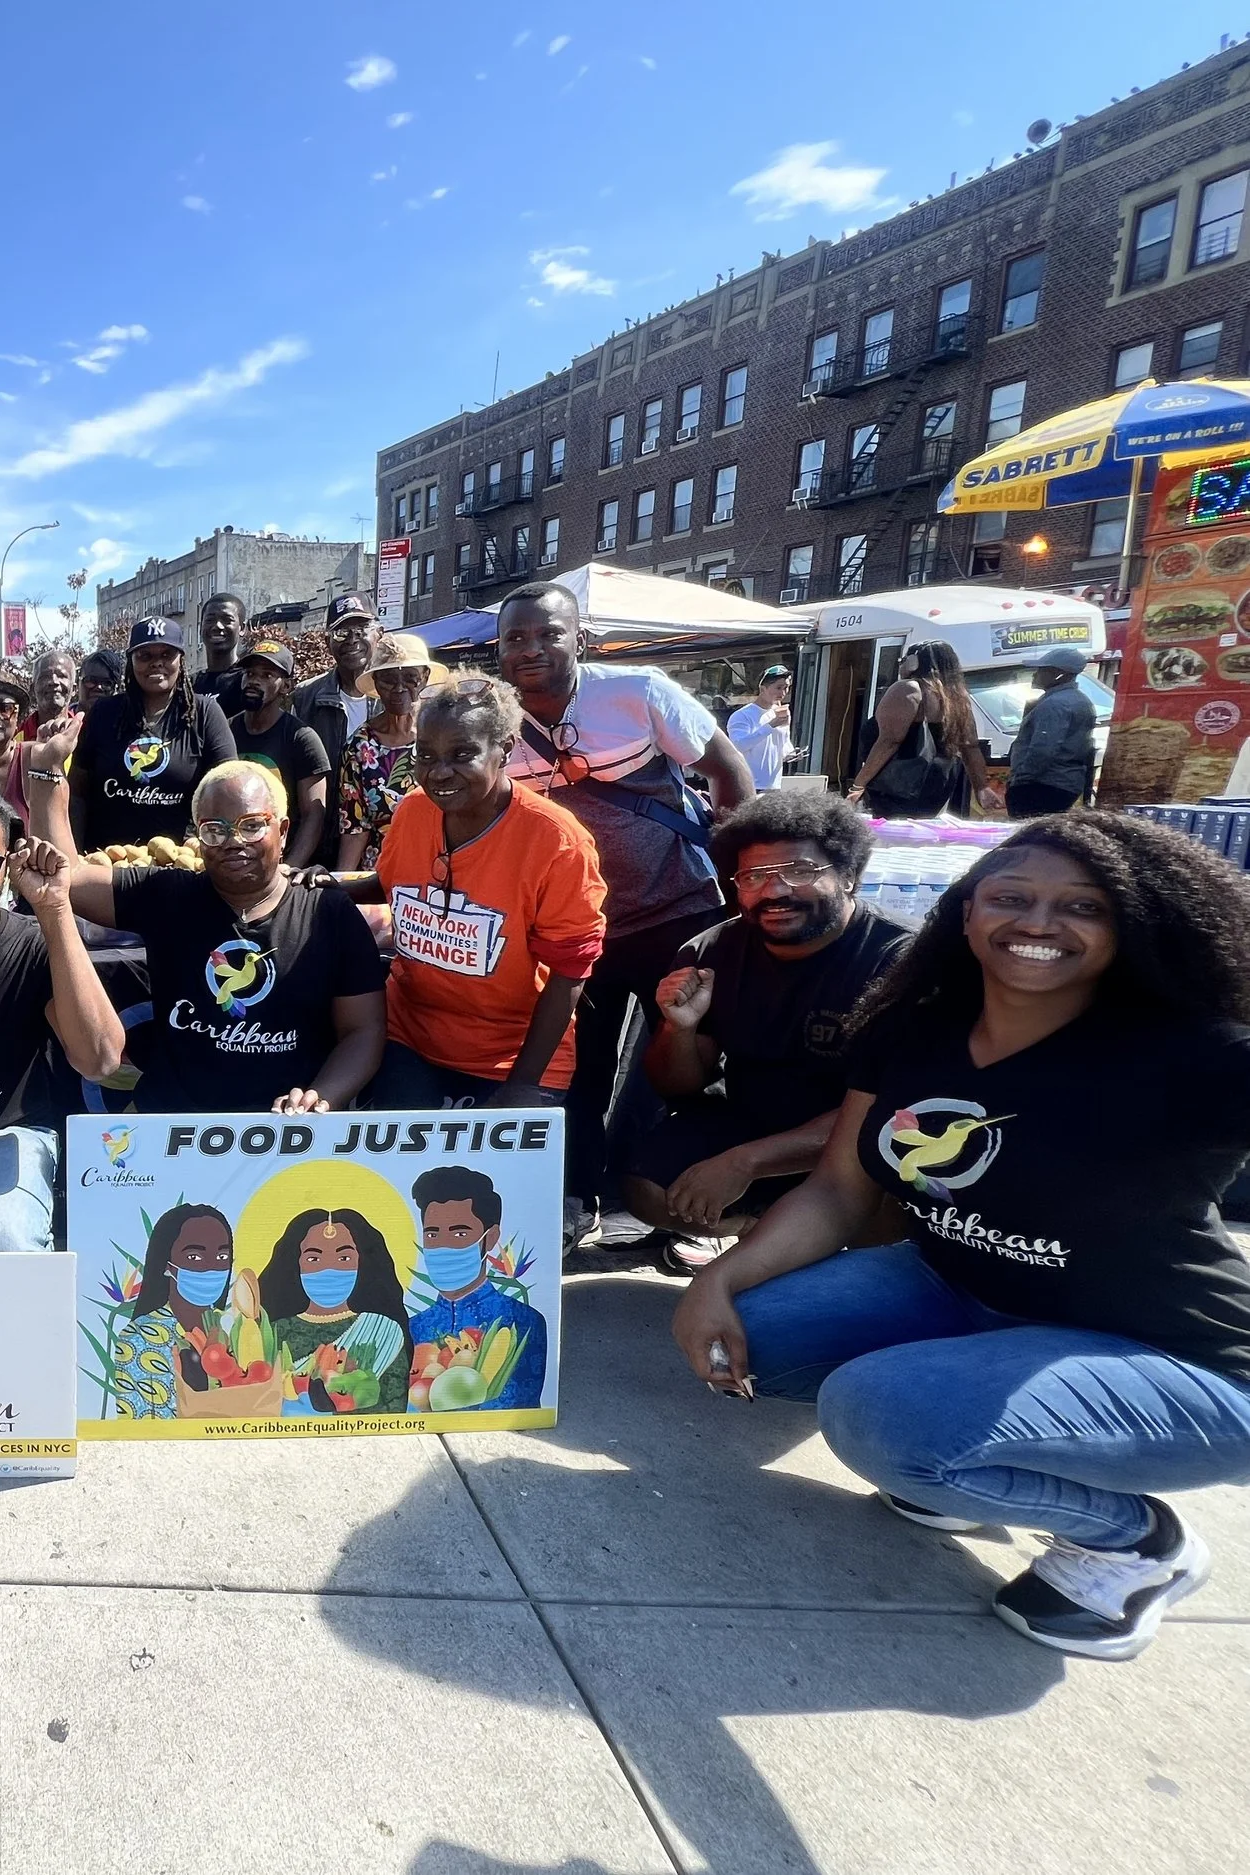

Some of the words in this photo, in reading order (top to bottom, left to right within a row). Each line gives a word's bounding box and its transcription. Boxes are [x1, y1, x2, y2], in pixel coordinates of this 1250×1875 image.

[1184, 430, 1192, 438] A
[1195, 426, 1224, 437] ROLL
[962, 440, 1101, 489] SABRETT
[835, 615, 863, 629] 1504
[1007, 629, 1048, 645] SUMMER
[1049, 627, 1069, 642] TIME
[103, 778, 185, 801] Caribbean
[399, 919, 471, 948] COMMUNITIES
[402, 904, 433, 927] NEW
[436, 918, 479, 939] YORK
[399, 931, 478, 967] CHANGE
[168, 999, 299, 1045] Caribbean
[215, 1040, 262, 1053] EQUALITY
[264, 1041, 297, 1053] PROJECT
[165, 1125, 315, 1156] FOOD
[332, 1119, 551, 1155] JUSTICE
[81, 1167, 156, 1187] Caribbean
[899, 1201, 1071, 1255] ribbean
[927, 1222, 992, 1253] EQUALITY
[996, 1245, 1067, 1268] PROJECT
[204, 1419, 426, 1434] www.CaribbeanEqualityProject.org
[27, 1443, 40, 1454] IN
[43, 1443, 71, 1454] NYC
